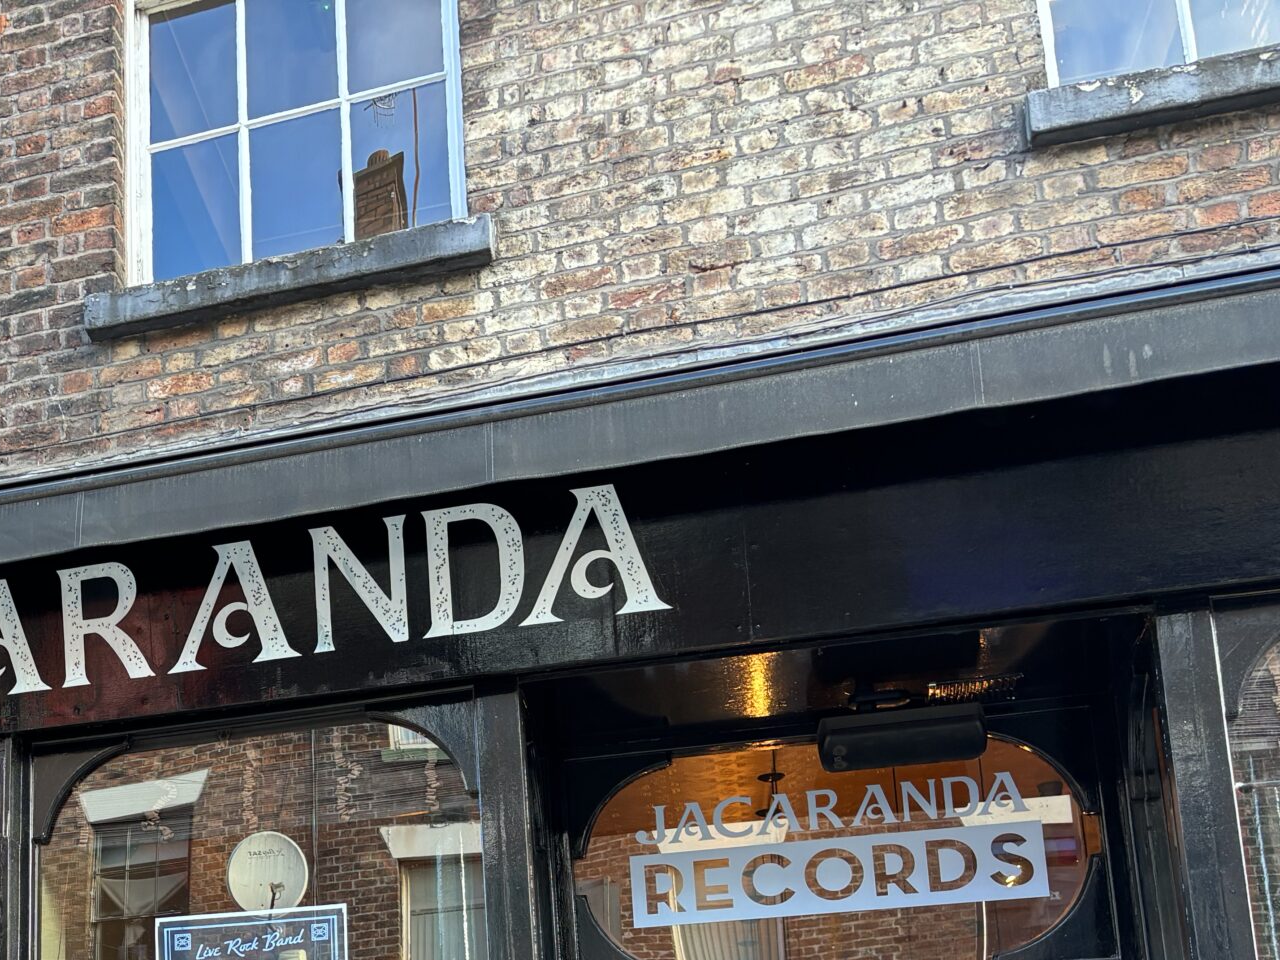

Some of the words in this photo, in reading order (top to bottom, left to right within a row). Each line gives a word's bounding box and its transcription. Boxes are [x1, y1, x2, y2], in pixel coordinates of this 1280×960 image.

[635, 771, 1031, 846] JACARANDA
[644, 833, 1035, 915] RECORDS
[196, 943, 221, 960] Live
[224, 936, 260, 957] Rock
[263, 929, 304, 951] Band
